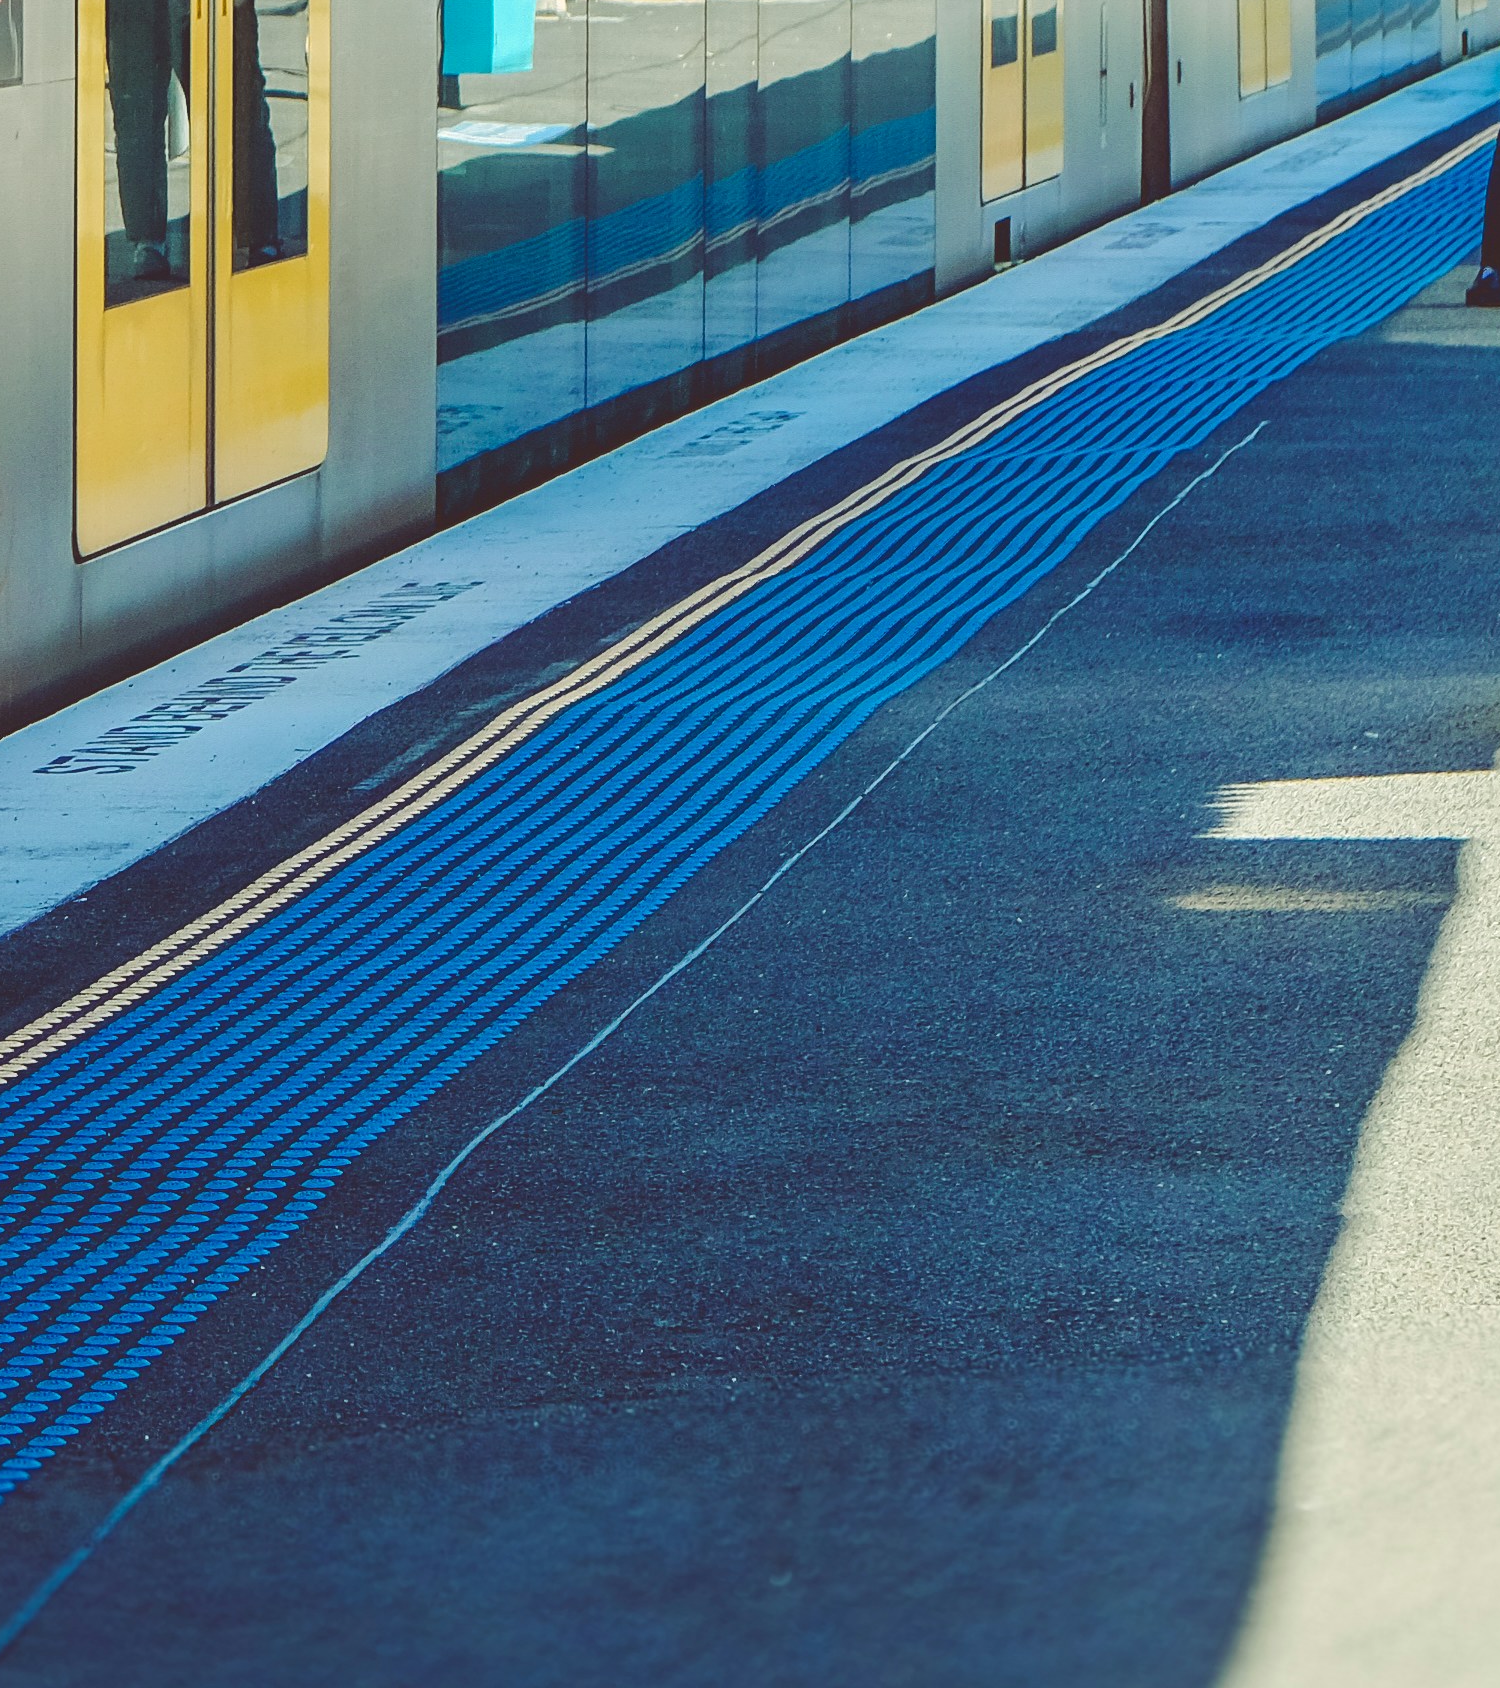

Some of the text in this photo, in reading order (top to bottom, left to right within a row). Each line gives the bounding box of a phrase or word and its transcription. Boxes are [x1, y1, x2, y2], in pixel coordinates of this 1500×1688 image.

[32, 725, 203, 774] STAND
[127, 675, 298, 722] BEHIND
[226, 650, 353, 672] THE
